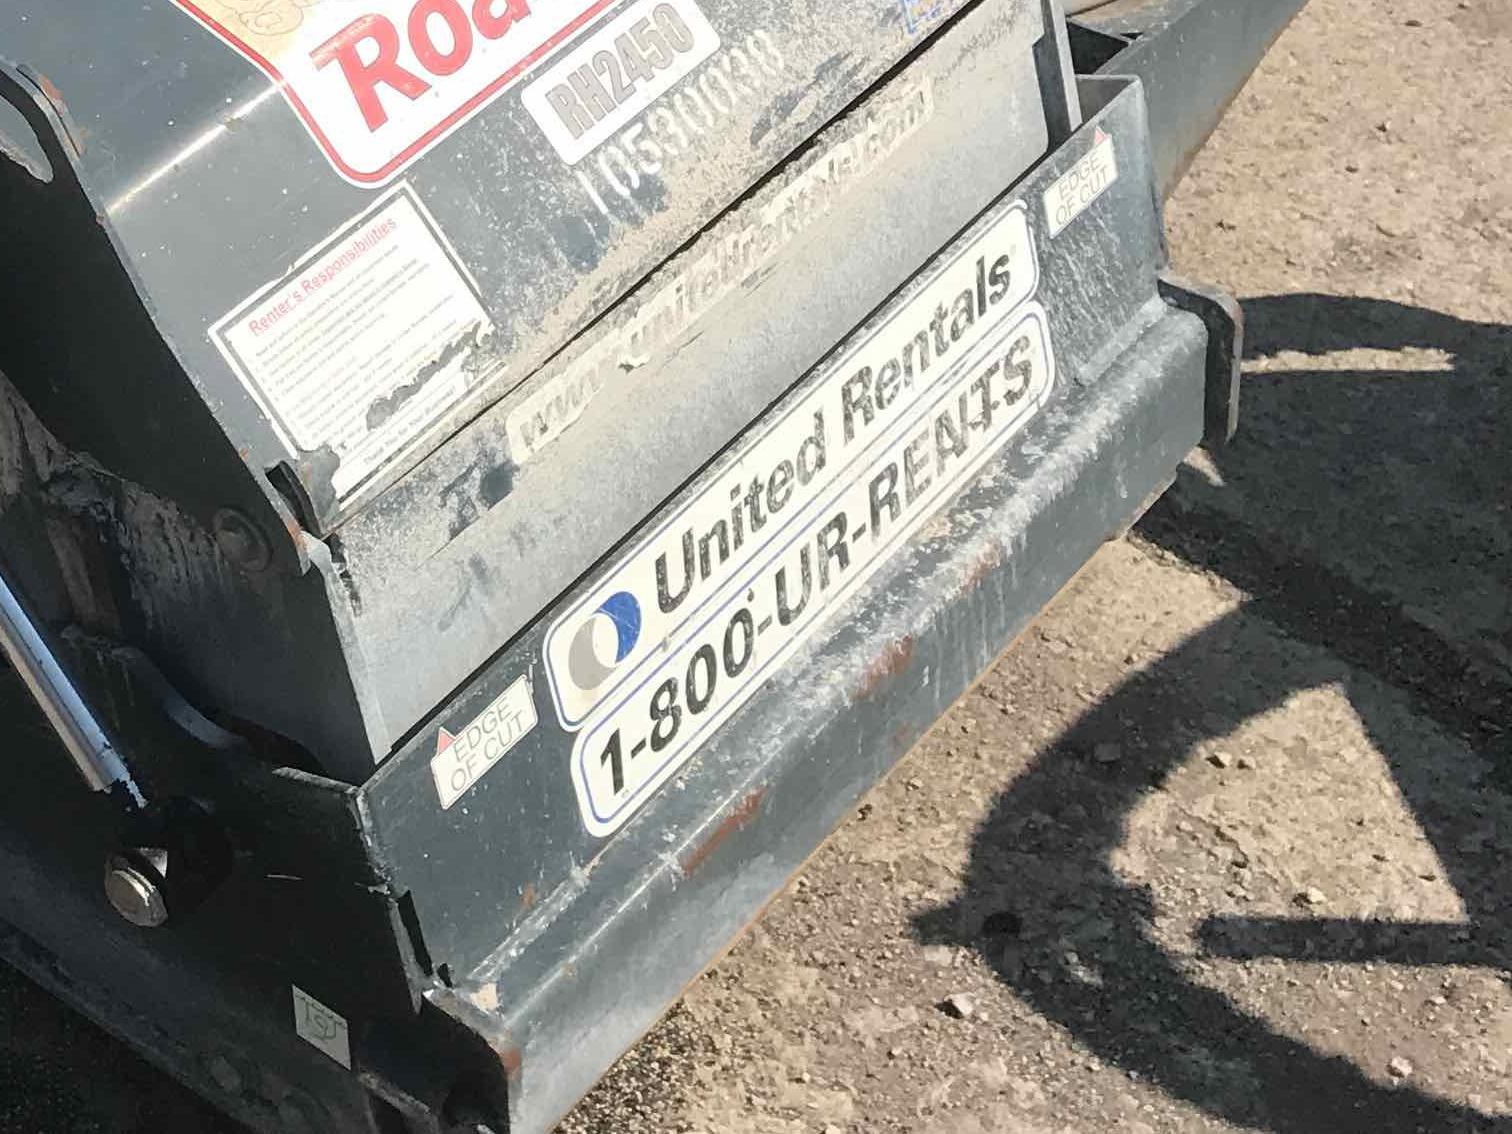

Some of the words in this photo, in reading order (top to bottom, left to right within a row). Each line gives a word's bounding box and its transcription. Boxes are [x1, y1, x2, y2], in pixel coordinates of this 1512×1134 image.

[545, 3, 696, 140] RH2450
[1056, 196, 1076, 225] OF
[1080, 164, 1109, 204] CUT
[1058, 151, 1101, 200] EDGE
[248, 289, 304, 337] Renter's
[300, 217, 398, 295] Responsibilities
[655, 406, 827, 614] United
[841, 253, 1011, 447] Rentals
[599, 335, 1033, 796] 1-800-UR-RENTS
[450, 753, 478, 792] OF
[483, 709, 524, 761] CUT
[453, 697, 511, 763] EDGE
